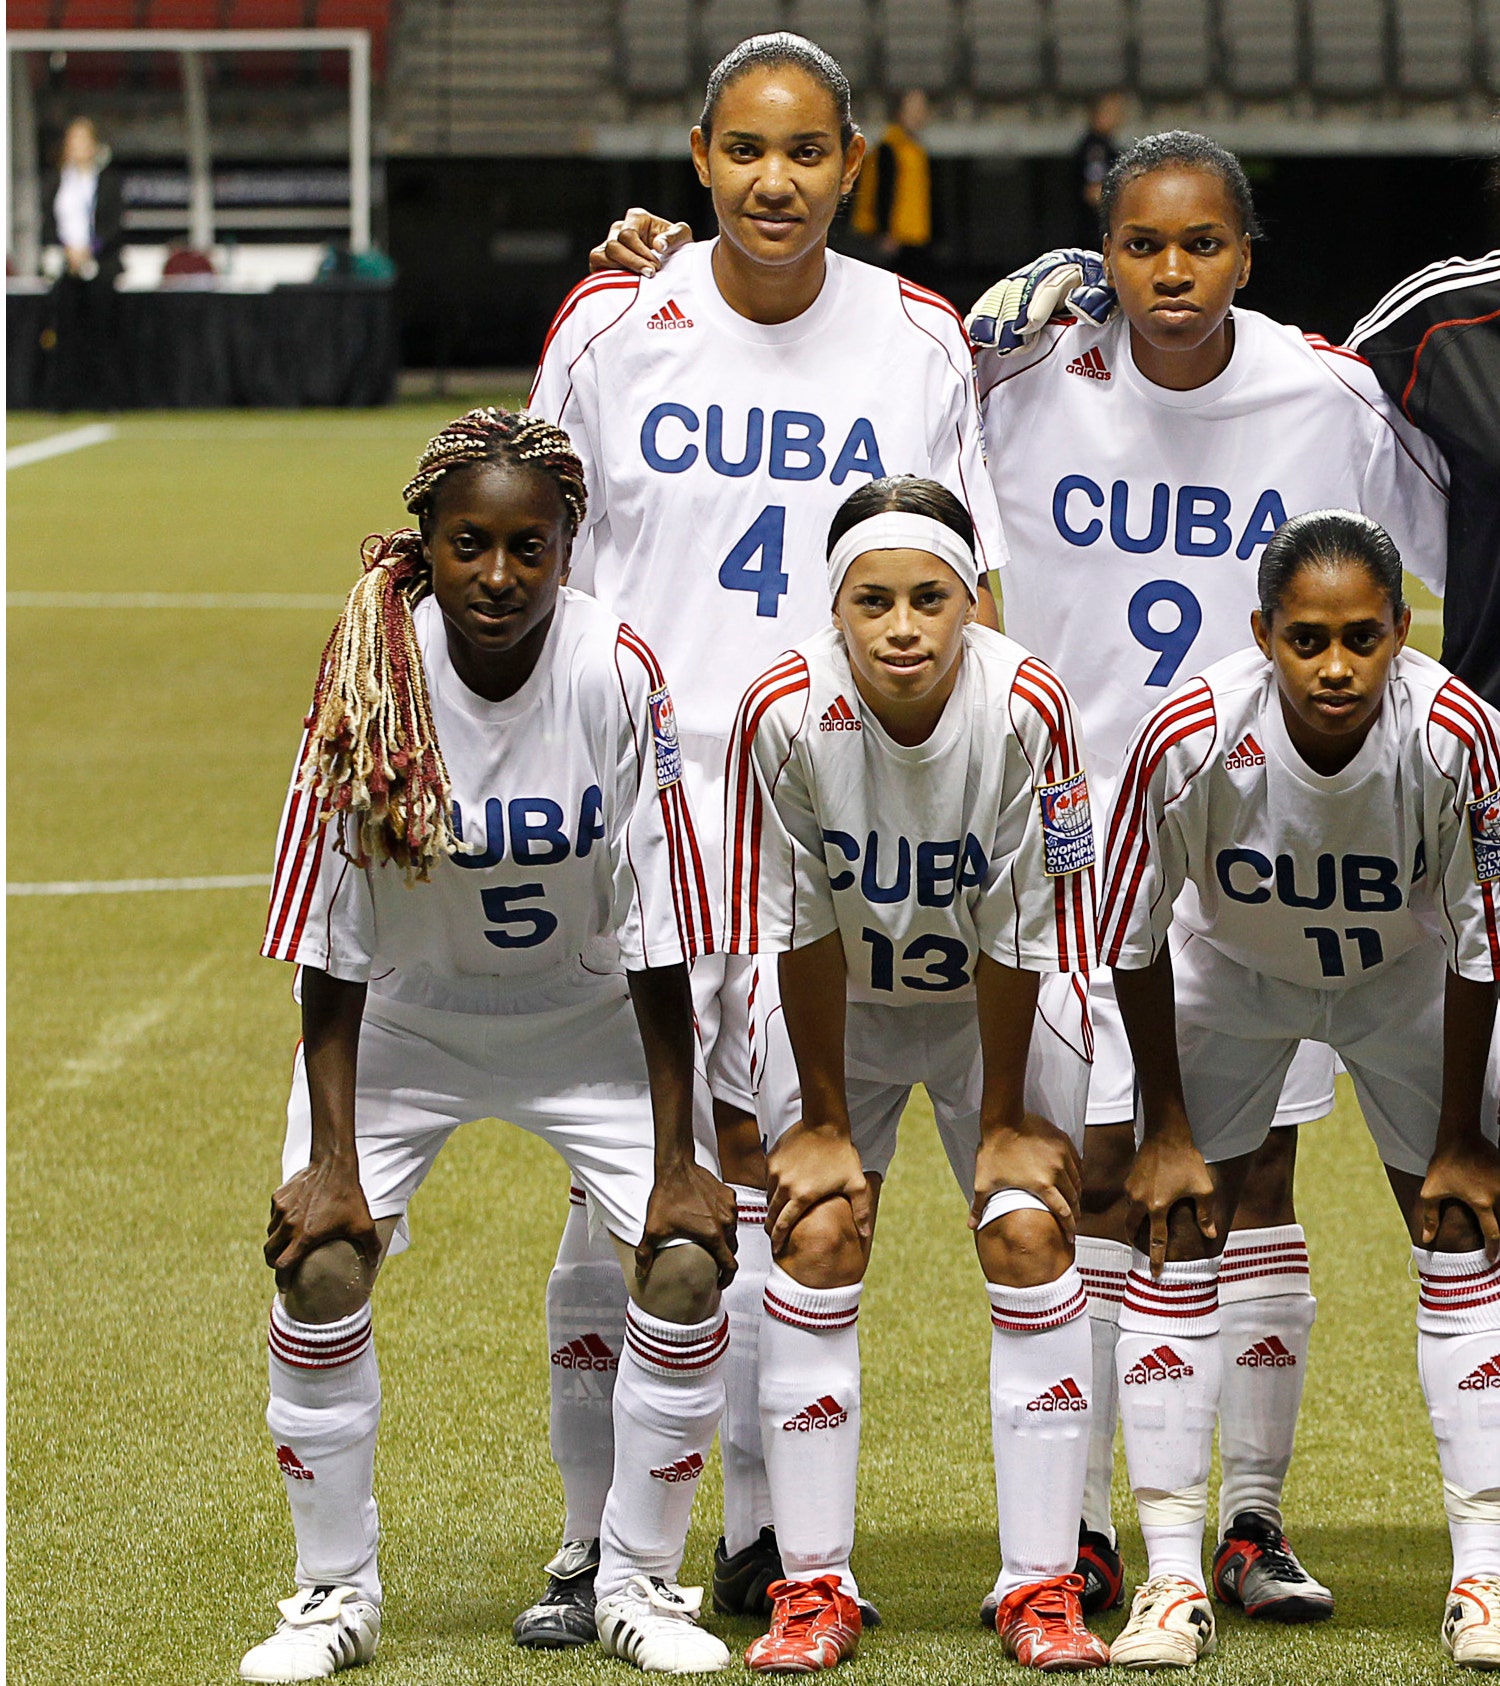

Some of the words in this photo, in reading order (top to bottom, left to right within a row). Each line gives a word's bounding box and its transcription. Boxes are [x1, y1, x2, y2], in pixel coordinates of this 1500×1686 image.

[646, 316, 694, 330] adidas
[1065, 362, 1112, 381] adidas
[640, 402, 887, 486] CUBA
[718, 505, 789, 618] 4
[1128, 579, 1202, 687] 9
[819, 718, 862, 732] adidas
[1225, 754, 1266, 770] adida
[412, 784, 606, 869] UBA
[480, 883, 558, 949] 5
[861, 926, 970, 993] 13
[1303, 926, 1384, 977] 11
[1236, 1353, 1297, 1368] adidas
[1124, 1364, 1194, 1386] adidas
[1026, 1396, 1088, 1412] adidas
[782, 1410, 848, 1433] adidas
